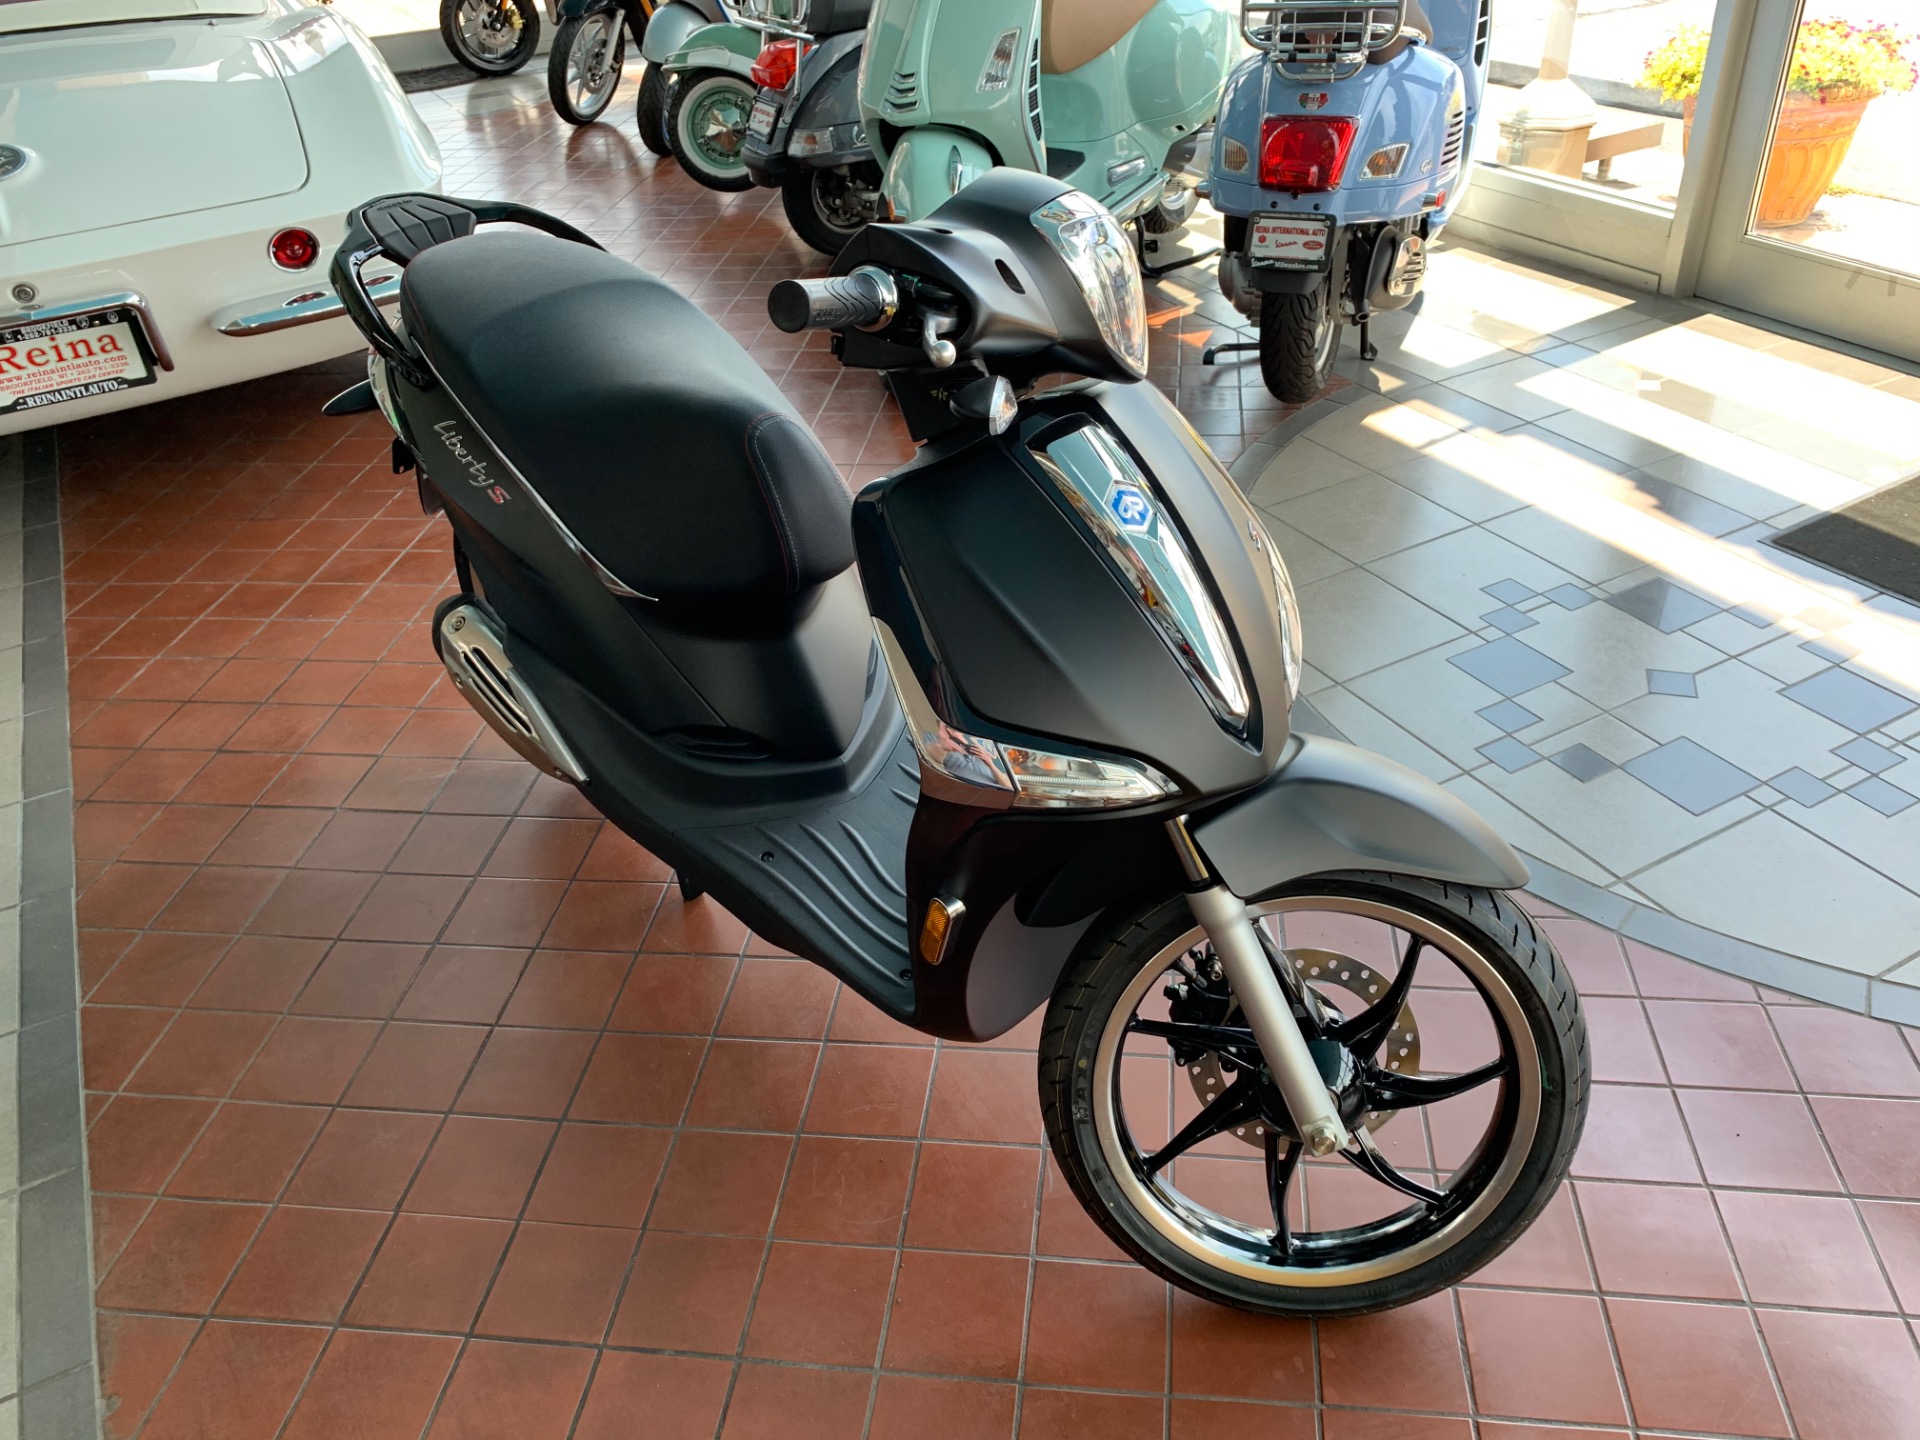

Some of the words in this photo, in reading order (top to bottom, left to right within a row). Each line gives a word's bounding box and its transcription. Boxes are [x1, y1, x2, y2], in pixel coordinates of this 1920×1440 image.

[1271, 227, 1310, 236] INTERNATIONAL
[20, 319, 69, 334] BROOKFIELD
[0, 334, 123, 375] Reina
[28, 383, 54, 392] ITALIAN
[56, 377, 82, 387] SPORTS
[433, 420, 495, 488] Liberty
[486, 485, 512, 504] S
